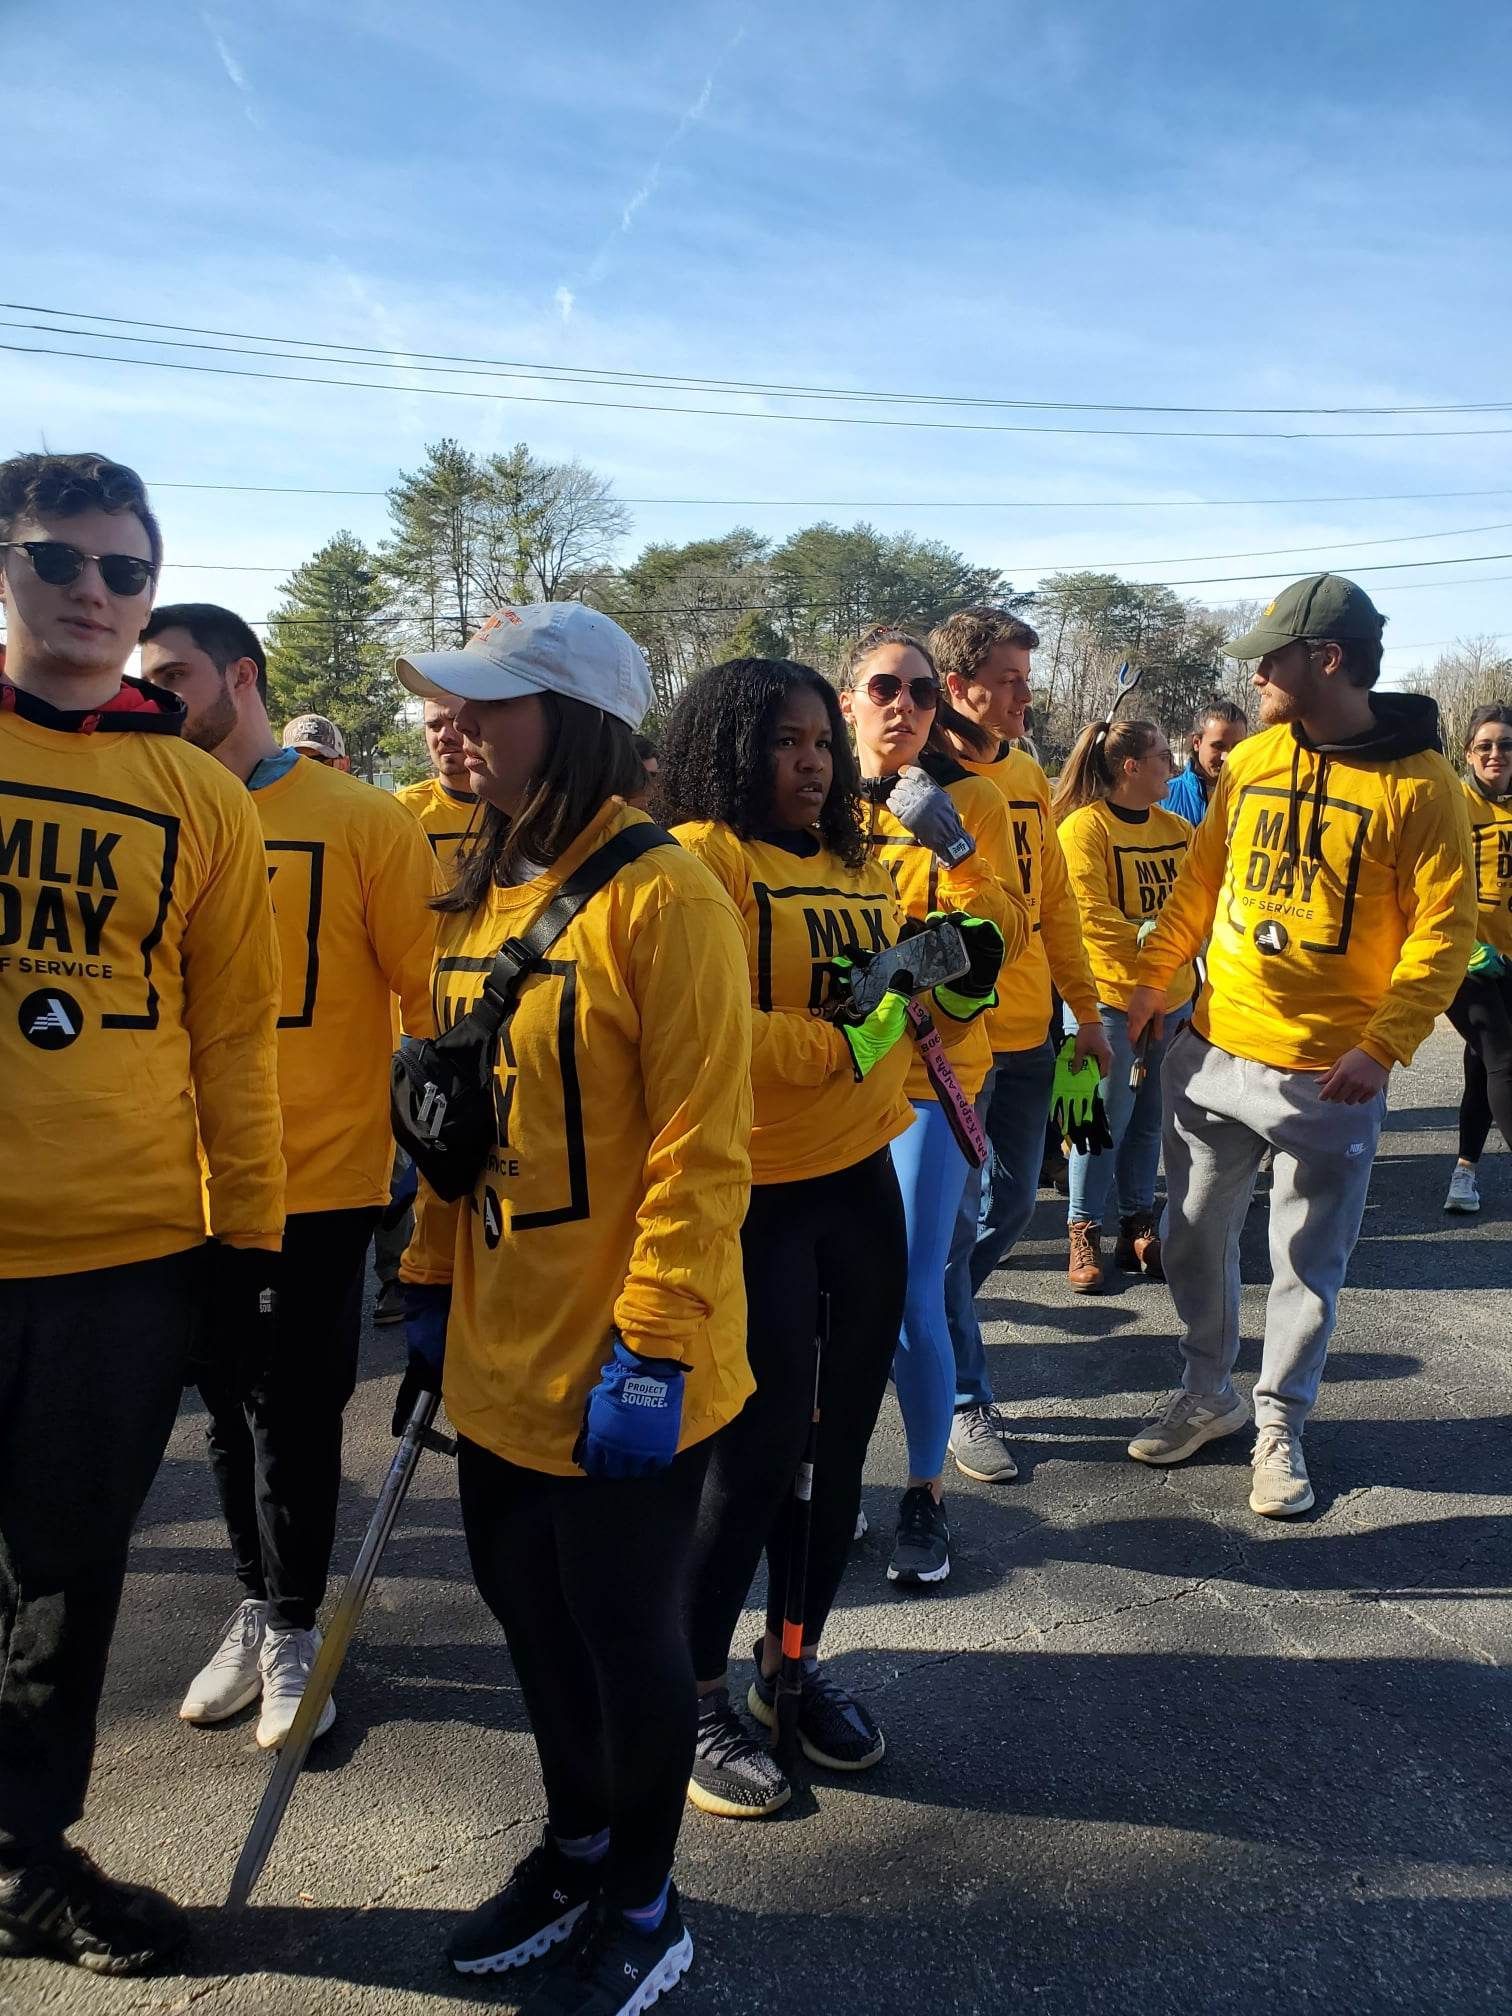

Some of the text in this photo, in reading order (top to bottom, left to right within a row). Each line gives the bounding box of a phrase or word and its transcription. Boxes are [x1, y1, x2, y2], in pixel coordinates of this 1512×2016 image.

[0, 816, 122, 890] MLK
[1134, 858, 1178, 884] MLK
[1244, 849, 1321, 903] DAY
[1242, 896, 1315, 920] OF SERVICE
[19, 957, 113, 979] SERVICE
[935, 1055, 957, 1091] Alpha
[956, 1092, 979, 1134] Kappa
[627, 1382, 665, 1396] PROJECT
